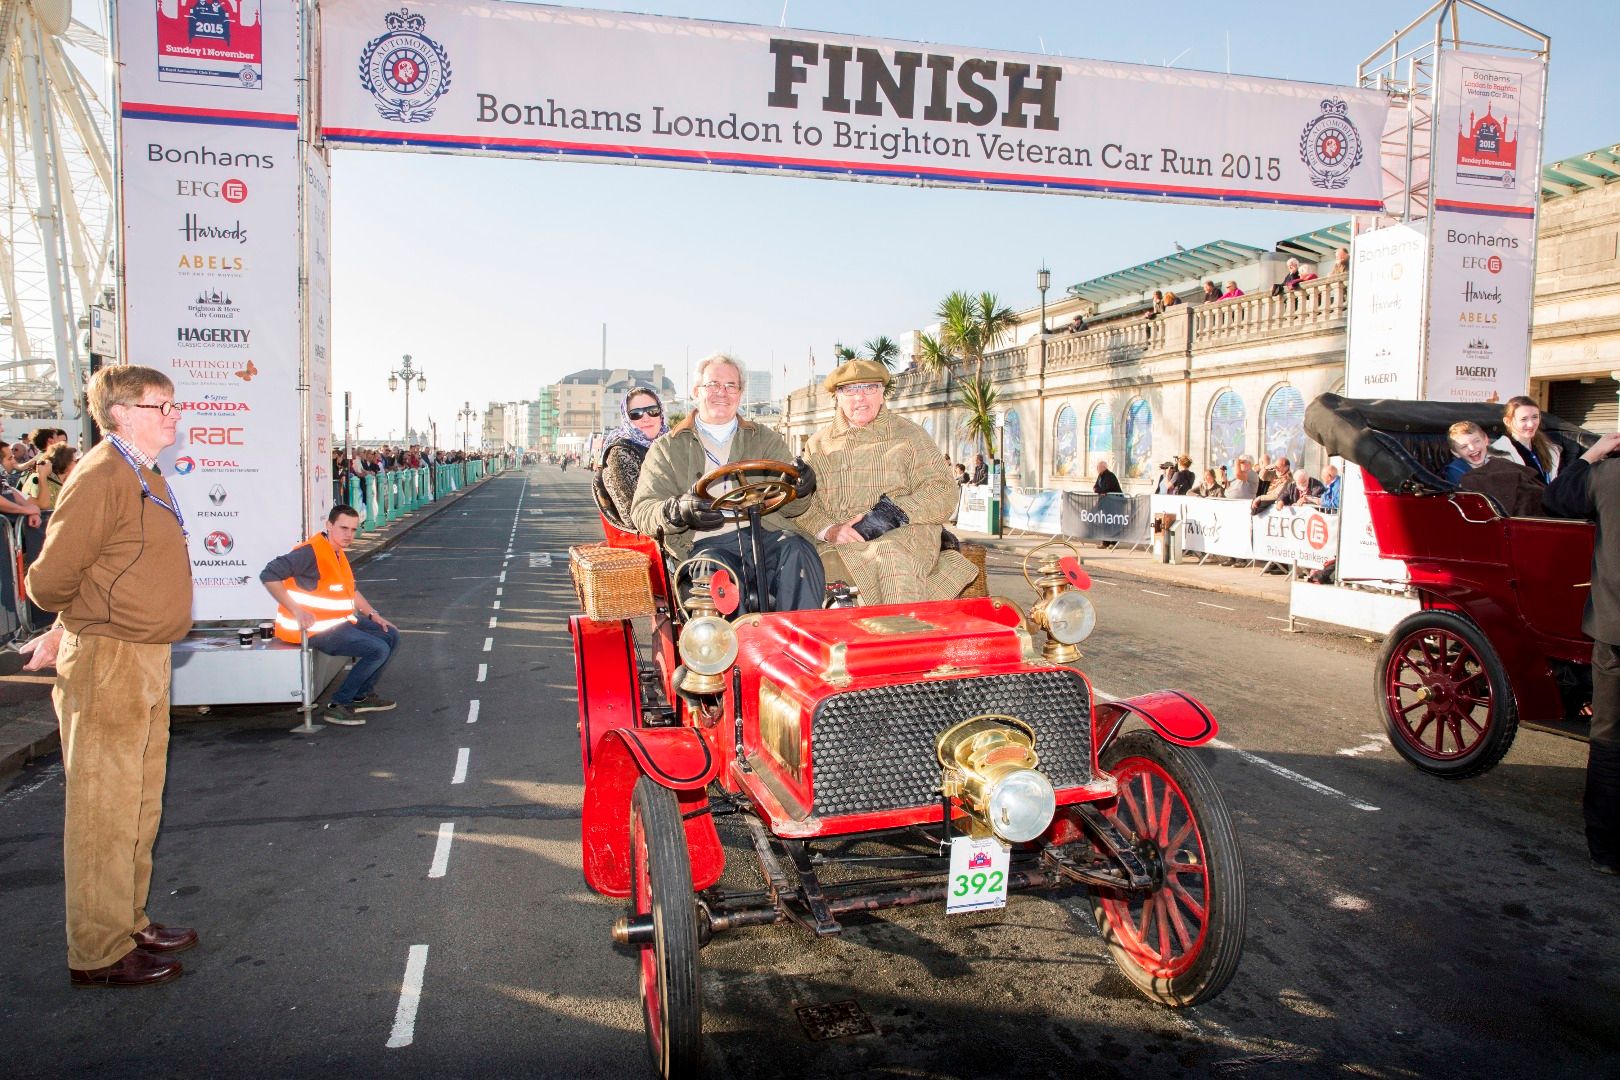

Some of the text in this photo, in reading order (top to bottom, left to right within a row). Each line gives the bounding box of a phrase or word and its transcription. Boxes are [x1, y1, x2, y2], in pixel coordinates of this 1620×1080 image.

[195, 22, 224, 34] 2015
[166, 44, 201, 57] Sunday
[208, 48, 254, 60] November
[372, 37, 439, 96] ROYAL AUTOMOBILE CLUB
[768, 38, 1062, 131] FINISH
[1464, 80, 1486, 89] London
[1473, 72, 1511, 82] Bonhams
[1467, 88, 1490, 97] Veteran
[476, 93, 1282, 182] Bonhams London to Brighton Veteran Car Run 2015
[1480, 140, 1496, 149] 2015
[148, 144, 274, 168] Bonhams
[176, 179, 220, 198] EFG
[178, 212, 248, 244] Harrods
[1447, 228, 1520, 249] Bonhams
[178, 254, 243, 270] ABELS
[1462, 256, 1487, 270] EFG
[1460, 281, 1502, 304] Harrods
[1459, 312, 1498, 324] ABELS
[177, 328, 250, 342] HAGERTY
[172, 358, 244, 369] HATTINGLEY
[189, 369, 229, 380] VALLEY
[1456, 366, 1498, 377] HAGERTY
[181, 402, 251, 411] HONDA
[200, 458, 240, 467] TOTAL
[1080, 509, 1130, 526] Bonhams
[1266, 516, 1306, 540] EFG
[1266, 545, 1330, 564] Private bankers
[192, 576, 240, 586] AMERICAN
[953, 870, 1004, 896] 392
